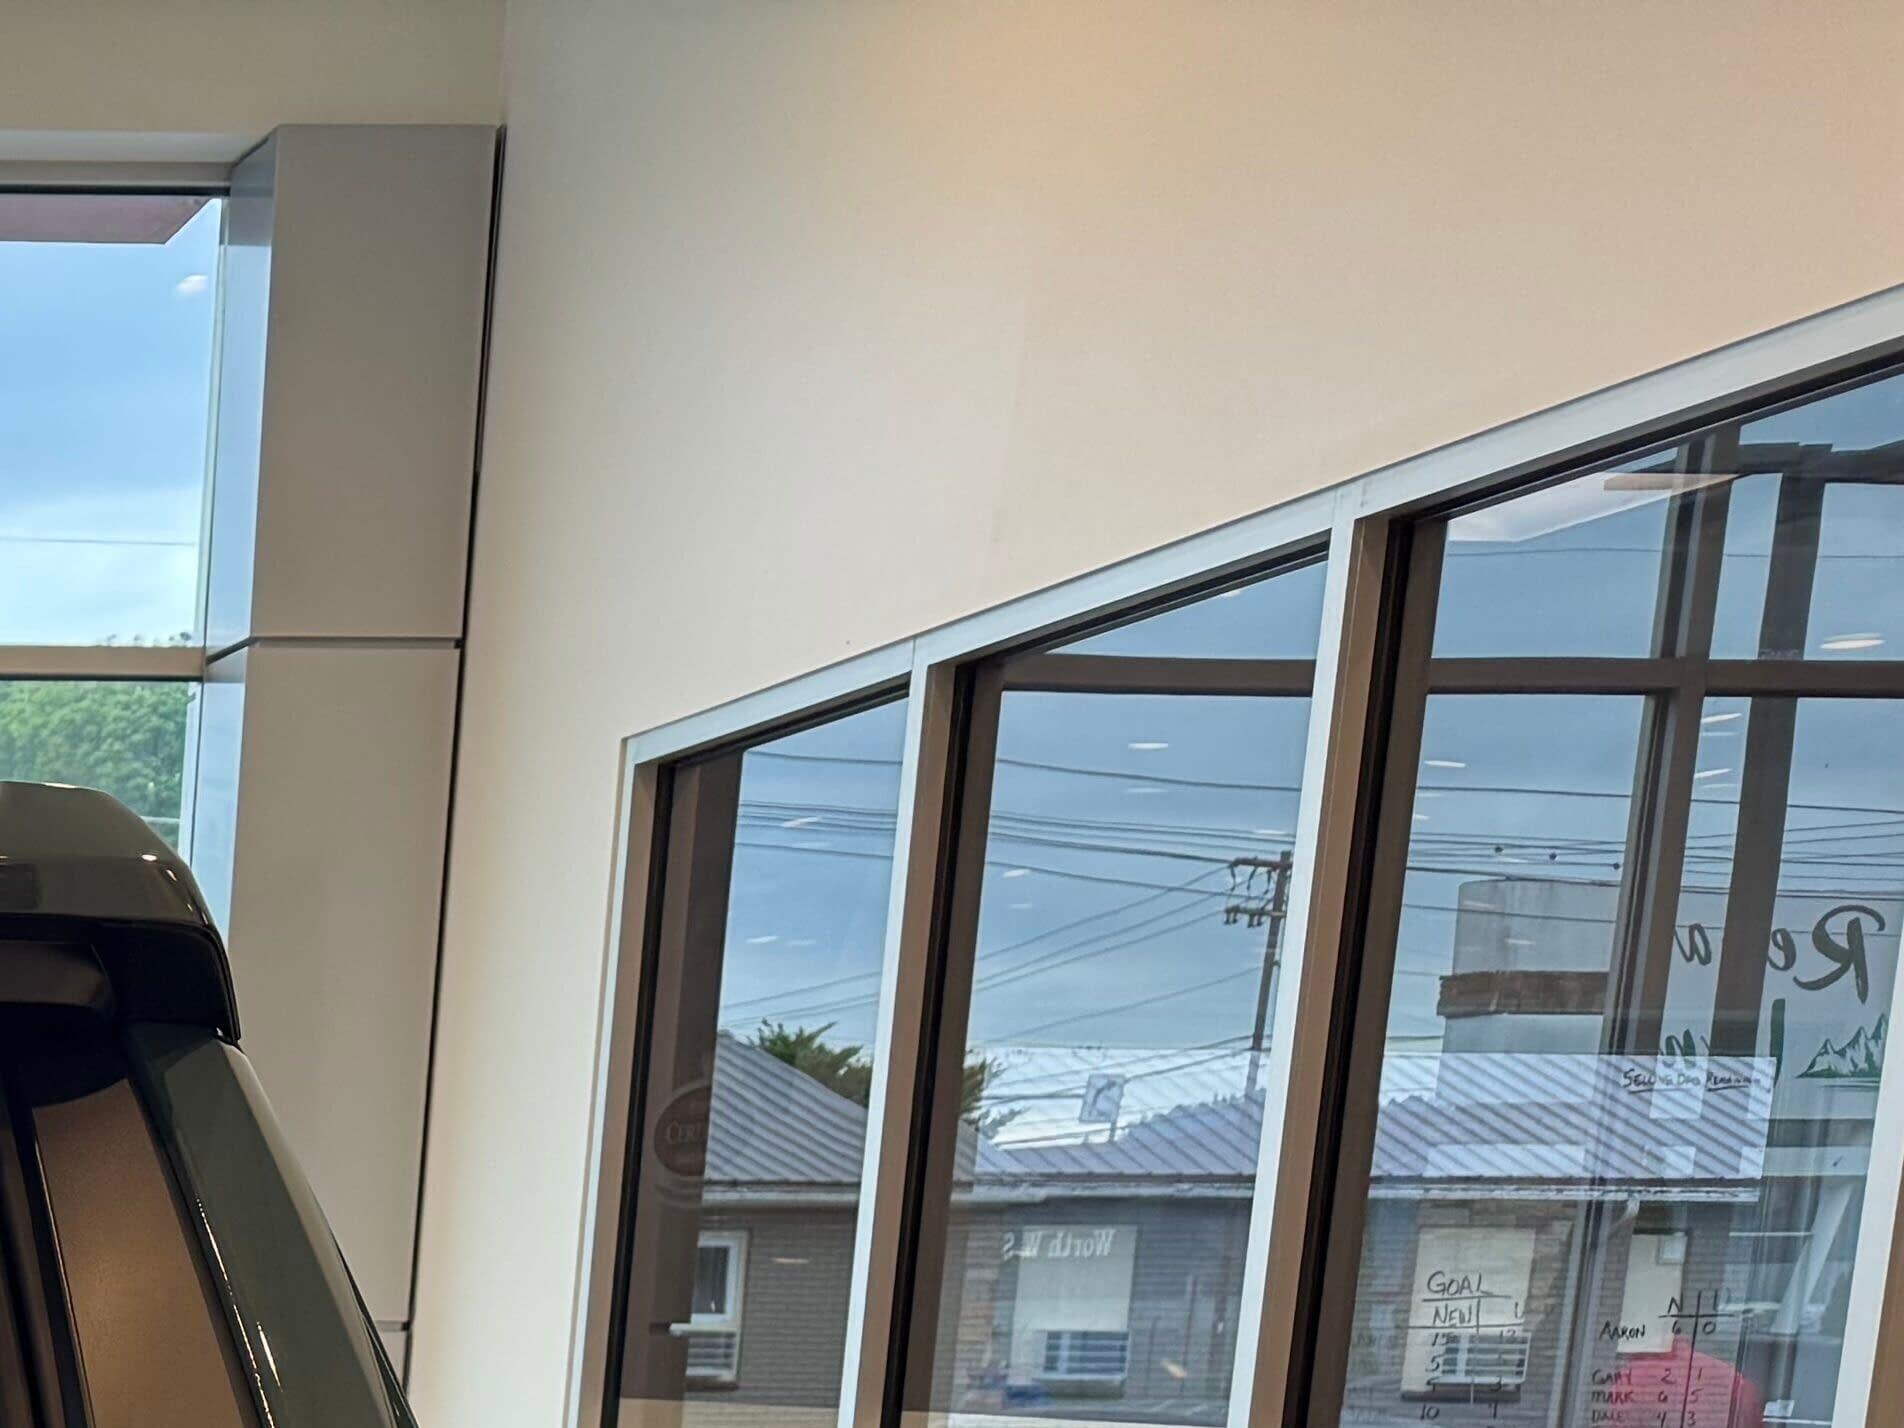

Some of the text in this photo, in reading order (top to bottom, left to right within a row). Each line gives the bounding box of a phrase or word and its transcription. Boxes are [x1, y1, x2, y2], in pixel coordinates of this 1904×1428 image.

[1426, 1270, 1492, 1297] GOAL
[1432, 1303, 1472, 1325] NEW
[1600, 1320, 1646, 1340] AARON
[1420, 1403, 1441, 1421] 10
